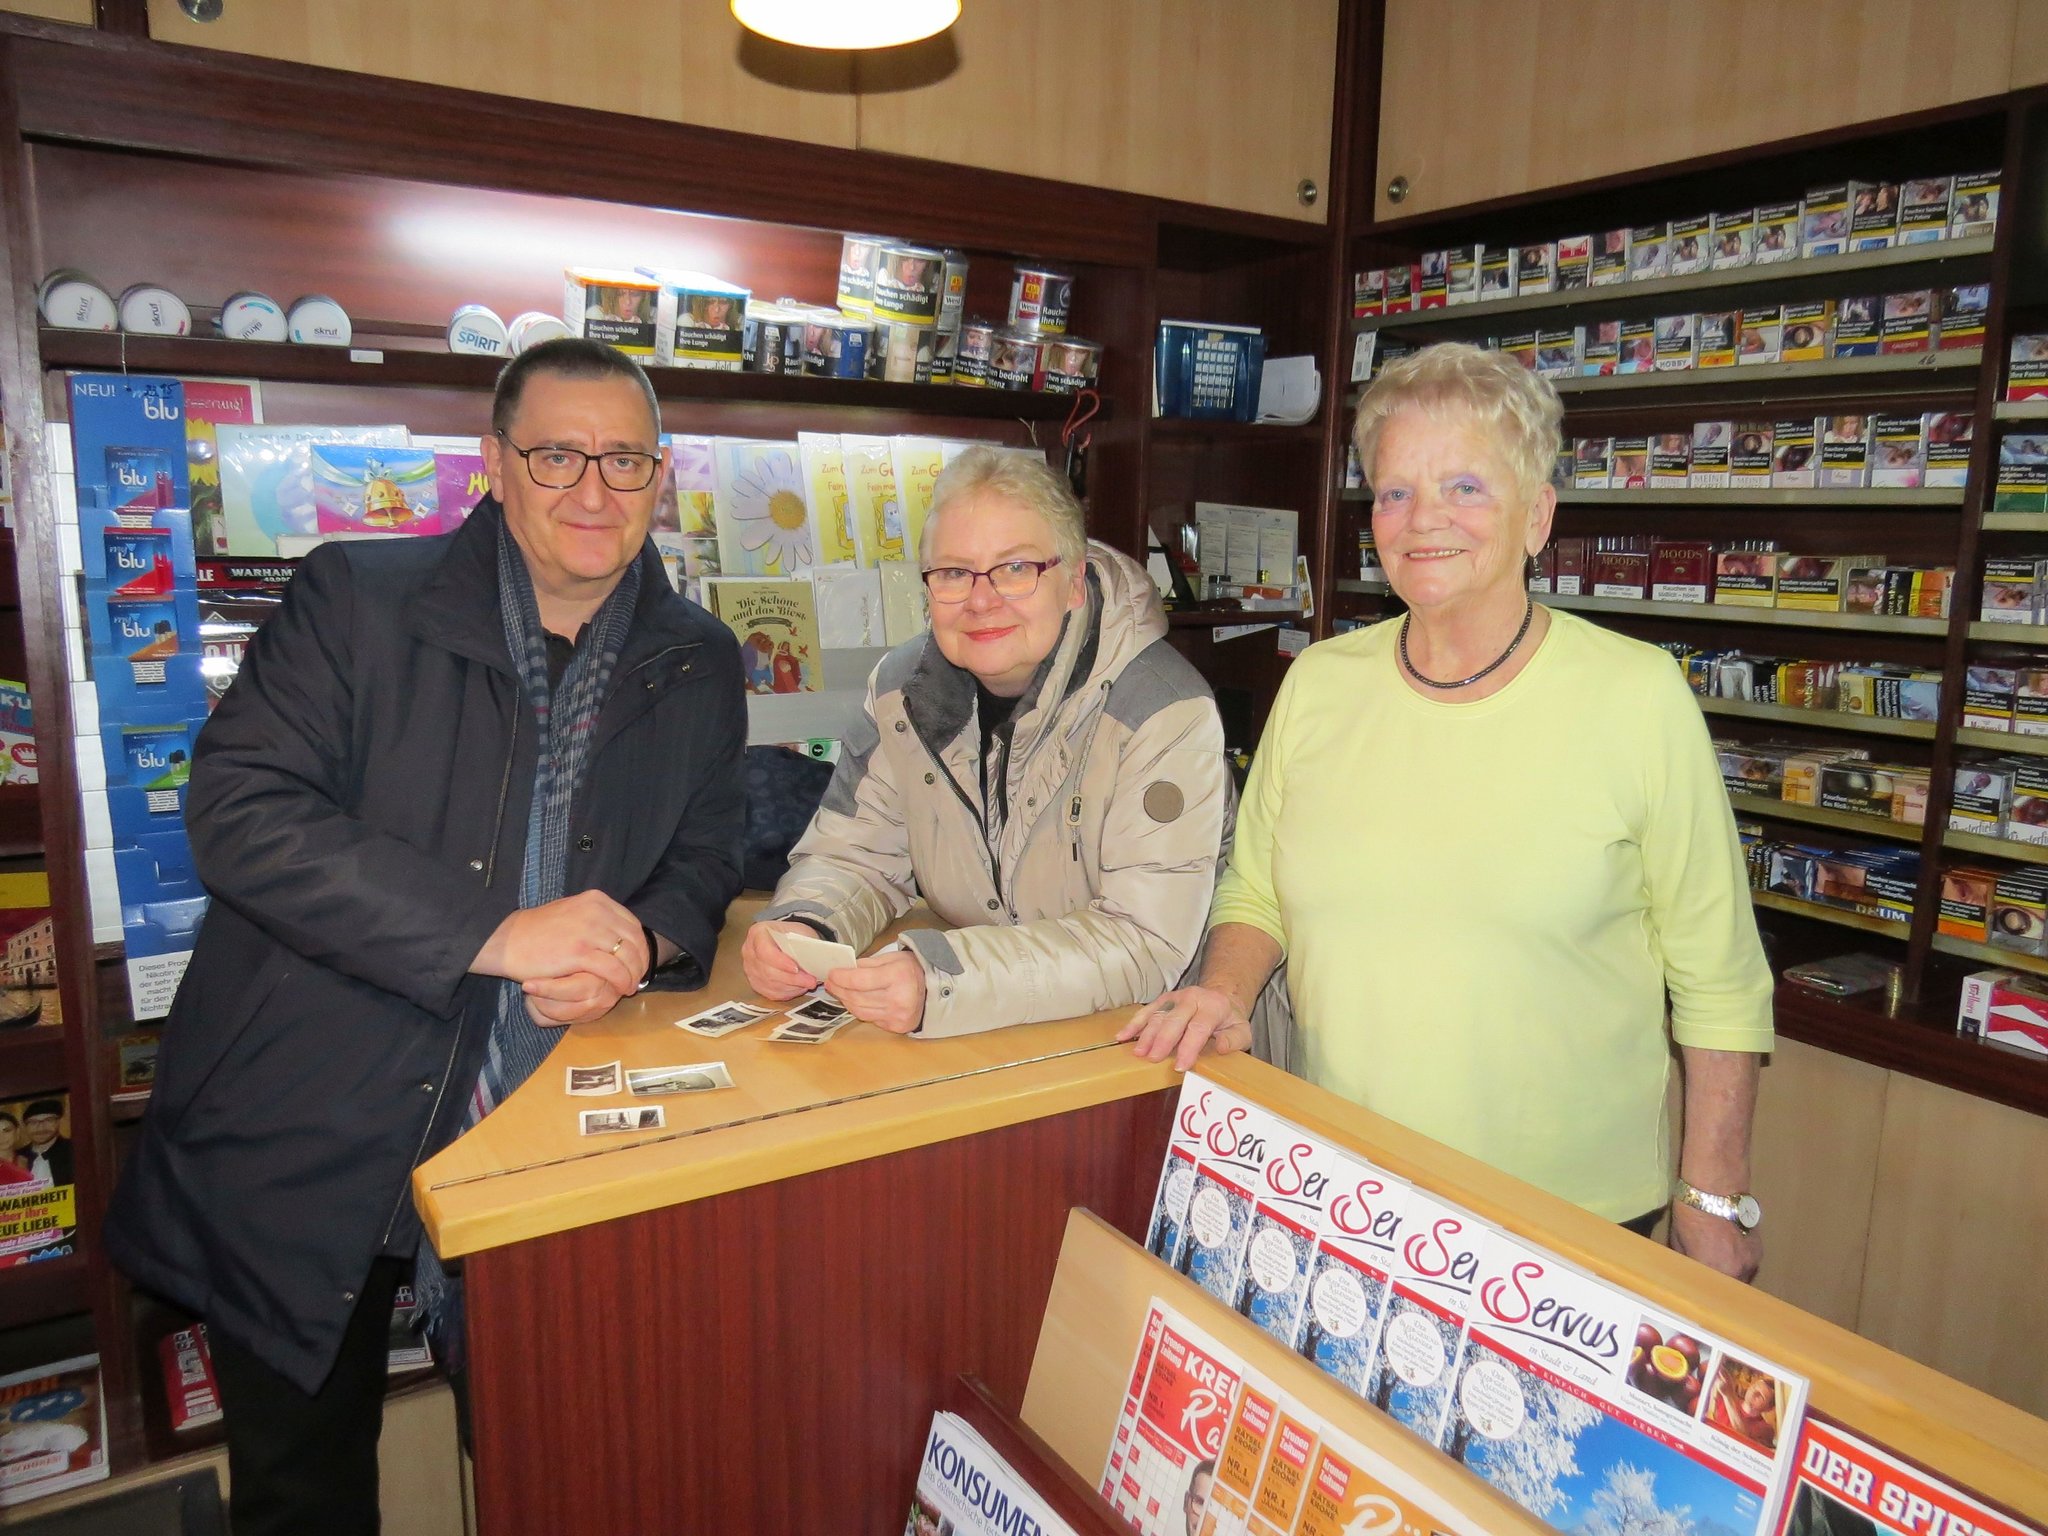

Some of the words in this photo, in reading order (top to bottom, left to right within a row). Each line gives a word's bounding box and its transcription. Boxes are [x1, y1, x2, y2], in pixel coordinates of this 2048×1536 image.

[884, 299, 904, 311] Lunge
[899, 293, 929, 304] schädigt
[589, 323, 615, 333] Rauchen
[615, 326, 639, 335] schädigt
[602, 332, 620, 341] Lunge
[680, 331, 704, 339] Rauchen
[457, 331, 500, 353] SPIRIT
[692, 339, 709, 347] Lunge
[1660, 359, 1687, 368] HOBBY
[998, 371, 1028, 383] bedroht
[74, 384, 116, 397] NEU!
[143, 397, 179, 420] blu
[119, 468, 148, 486] blu
[118, 553, 146, 569] blu
[1602, 556, 1640, 567] MOODS
[1659, 549, 1703, 560] MOODS
[230, 567, 297, 578] WARHAM
[736, 597, 757, 609] Die
[759, 595, 800, 609] Schöne
[730, 607, 753, 622] und
[755, 604, 775, 615] das
[777, 606, 807, 621] Biest
[122, 622, 151, 638] blu
[137, 753, 166, 768] blu
[138, 963, 166, 972] Dieses
[25, 1207, 49, 1218] ihre
[22, 1215, 59, 1233] LIEBE
[1480, 1261, 1619, 1358] Servus
[1163, 1331, 1186, 1355] Kronen
[1160, 1343, 1182, 1369] Zeitung
[1538, 1347, 1562, 1368] Stadt
[1573, 1367, 1598, 1387] Land
[1245, 1396, 1271, 1420] Kronen
[1543, 1371, 1589, 1401] EINFACH
[1599, 1401, 1621, 1417] GUT
[1632, 1419, 1669, 1443] LEBEN
[1242, 1408, 1267, 1434] Zeitung
[1234, 1434, 1259, 1456] KRONE
[1282, 1425, 1310, 1452] Kronen
[1279, 1438, 1306, 1464] Zeitung
[1270, 1465, 1297, 1488] KRONE
[1322, 1457, 1349, 1485] Kronen
[1802, 1437, 1874, 1506] DER
[1318, 1468, 1346, 1497] Zeitung
[923, 1463, 936, 1480] Das
[936, 1477, 983, 1528] österreichische
[1309, 1499, 1336, 1521] KRONE
